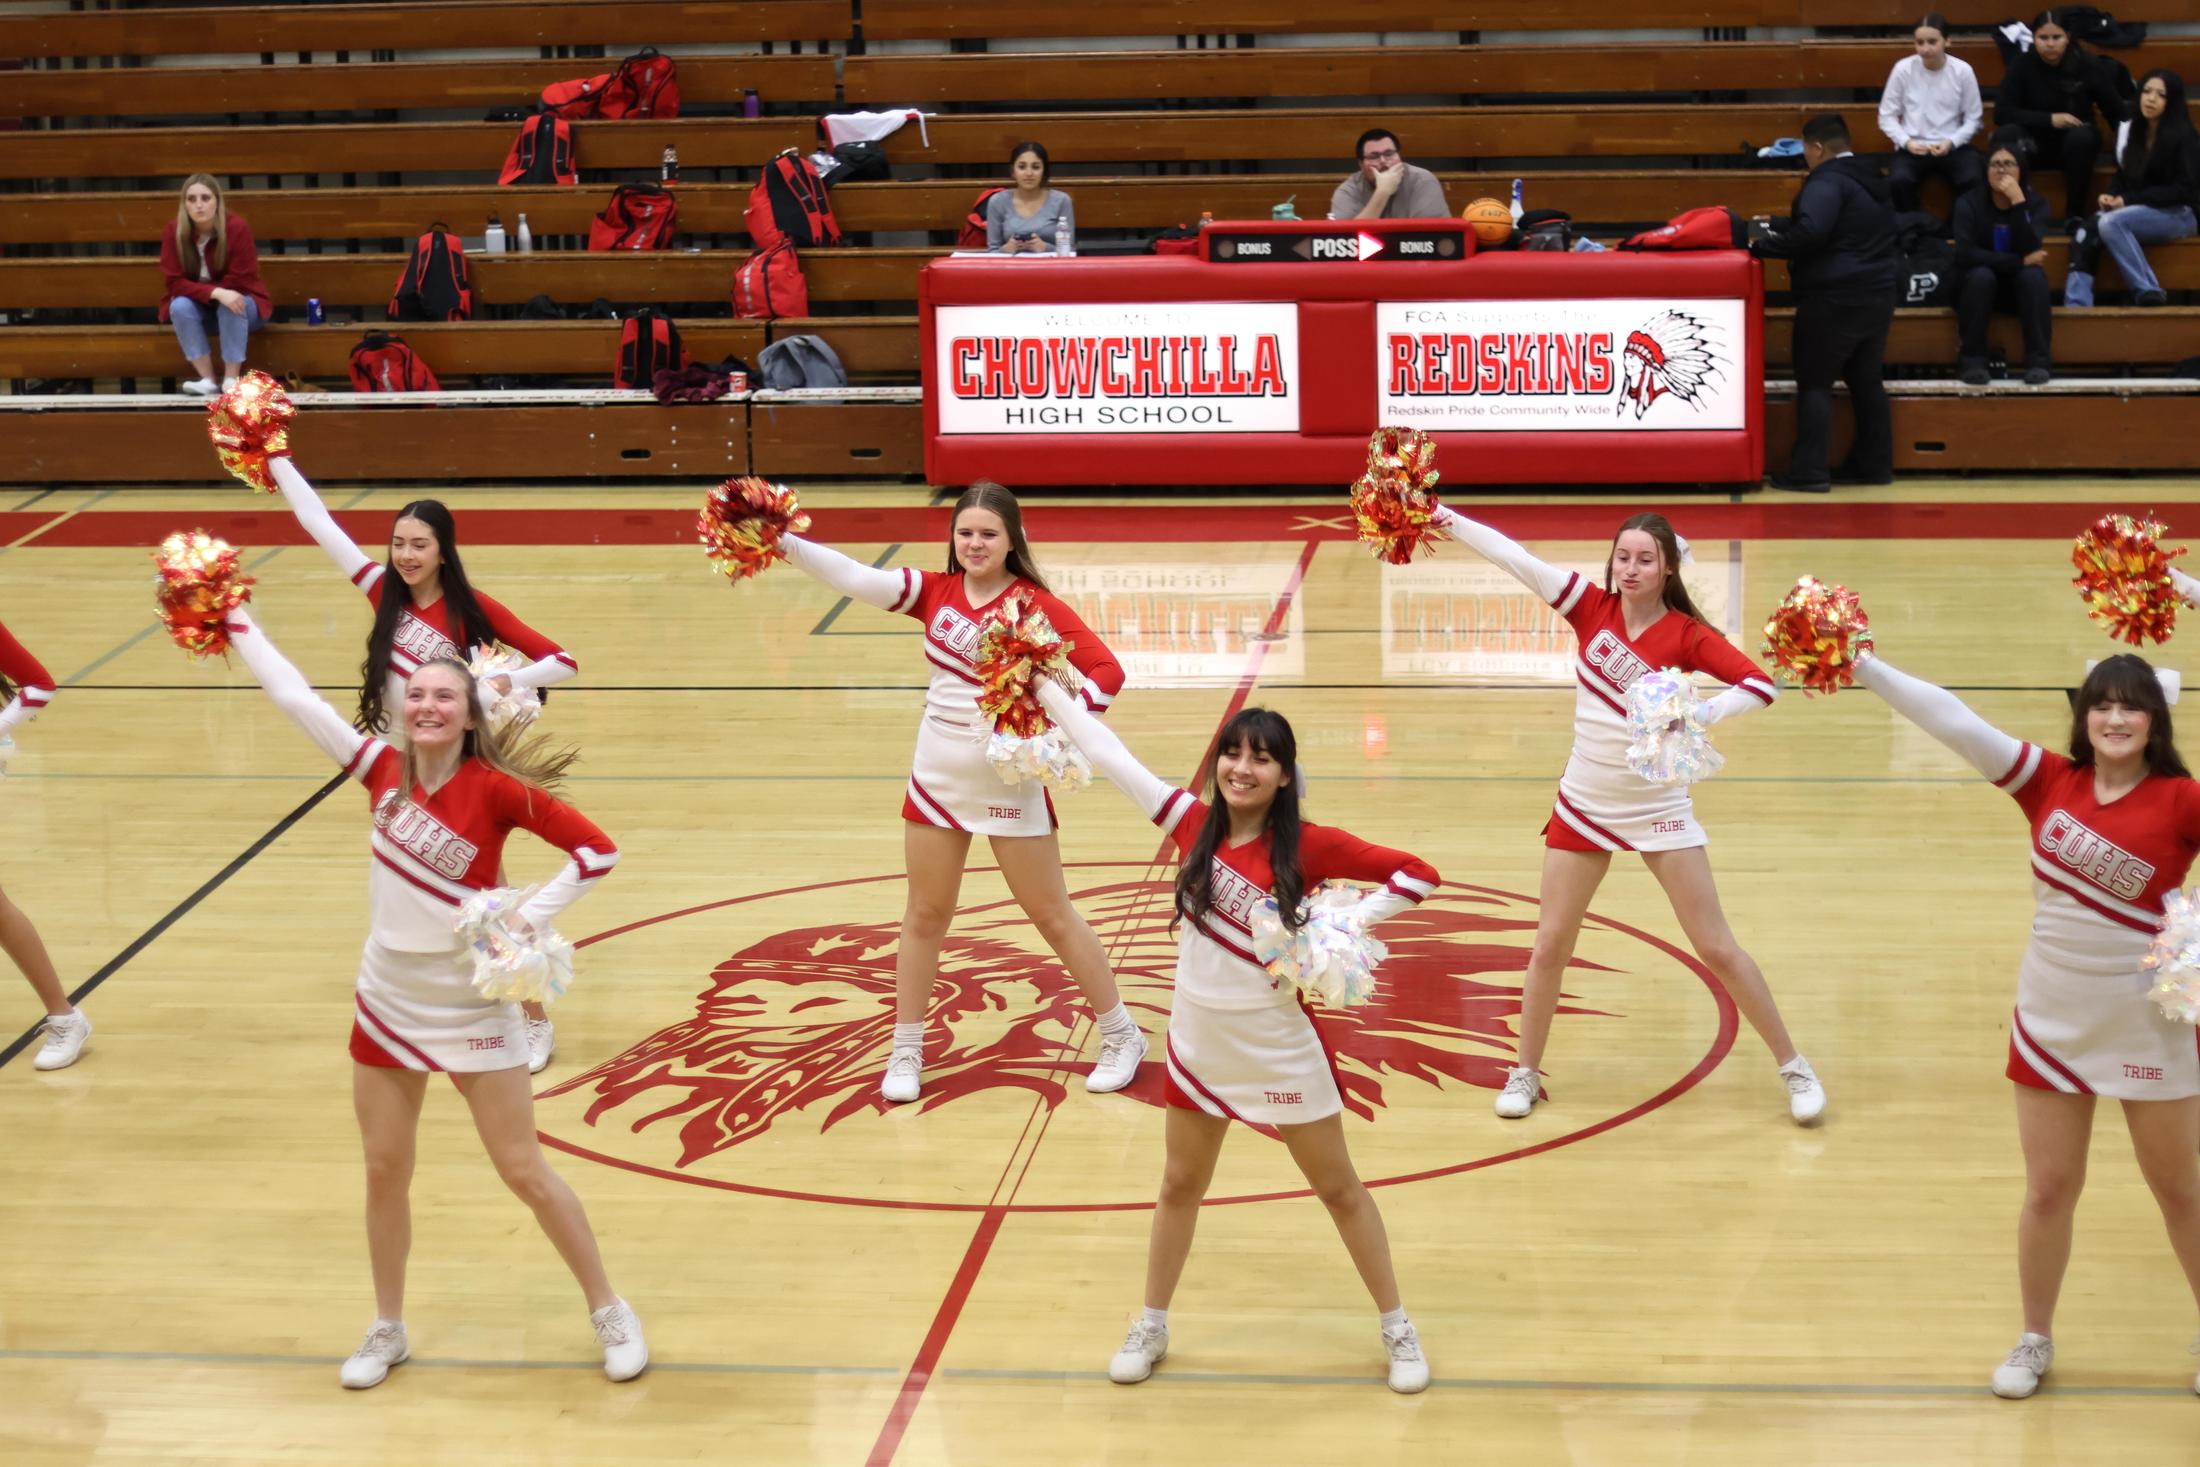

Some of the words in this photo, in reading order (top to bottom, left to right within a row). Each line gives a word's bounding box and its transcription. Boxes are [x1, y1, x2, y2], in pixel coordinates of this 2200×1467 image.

[1237, 242, 1271, 254] BONUS
[1312, 238, 1358, 258] POSS
[1400, 241, 1434, 254] BONUS
[1906, 272, 1939, 302] P
[1043, 313, 1153, 326] WELCOME
[1166, 313, 1191, 326] TO
[1405, 310, 1447, 323] FCA
[951, 333, 1287, 399] CHOWCHILLA
[1387, 331, 1615, 396] REDSKINS
[1005, 407, 1083, 424] HIGH
[1097, 405, 1233, 424] SCHOOL
[1387, 404, 1444, 416] Redskin
[1448, 404, 1485, 416] Pride
[1489, 404, 1570, 418] Community
[1575, 403, 1611, 415] Wide
[988, 807, 1021, 820] TRIBE
[374, 788, 478, 880] CUHS
[1652, 820, 1686, 833] TRIBE
[2039, 809, 2155, 900] CUHS
[467, 1036, 505, 1051] TRIBE
[2123, 1064, 2163, 1081] TRIBE
[1264, 1091, 1303, 1104] TRIBE
